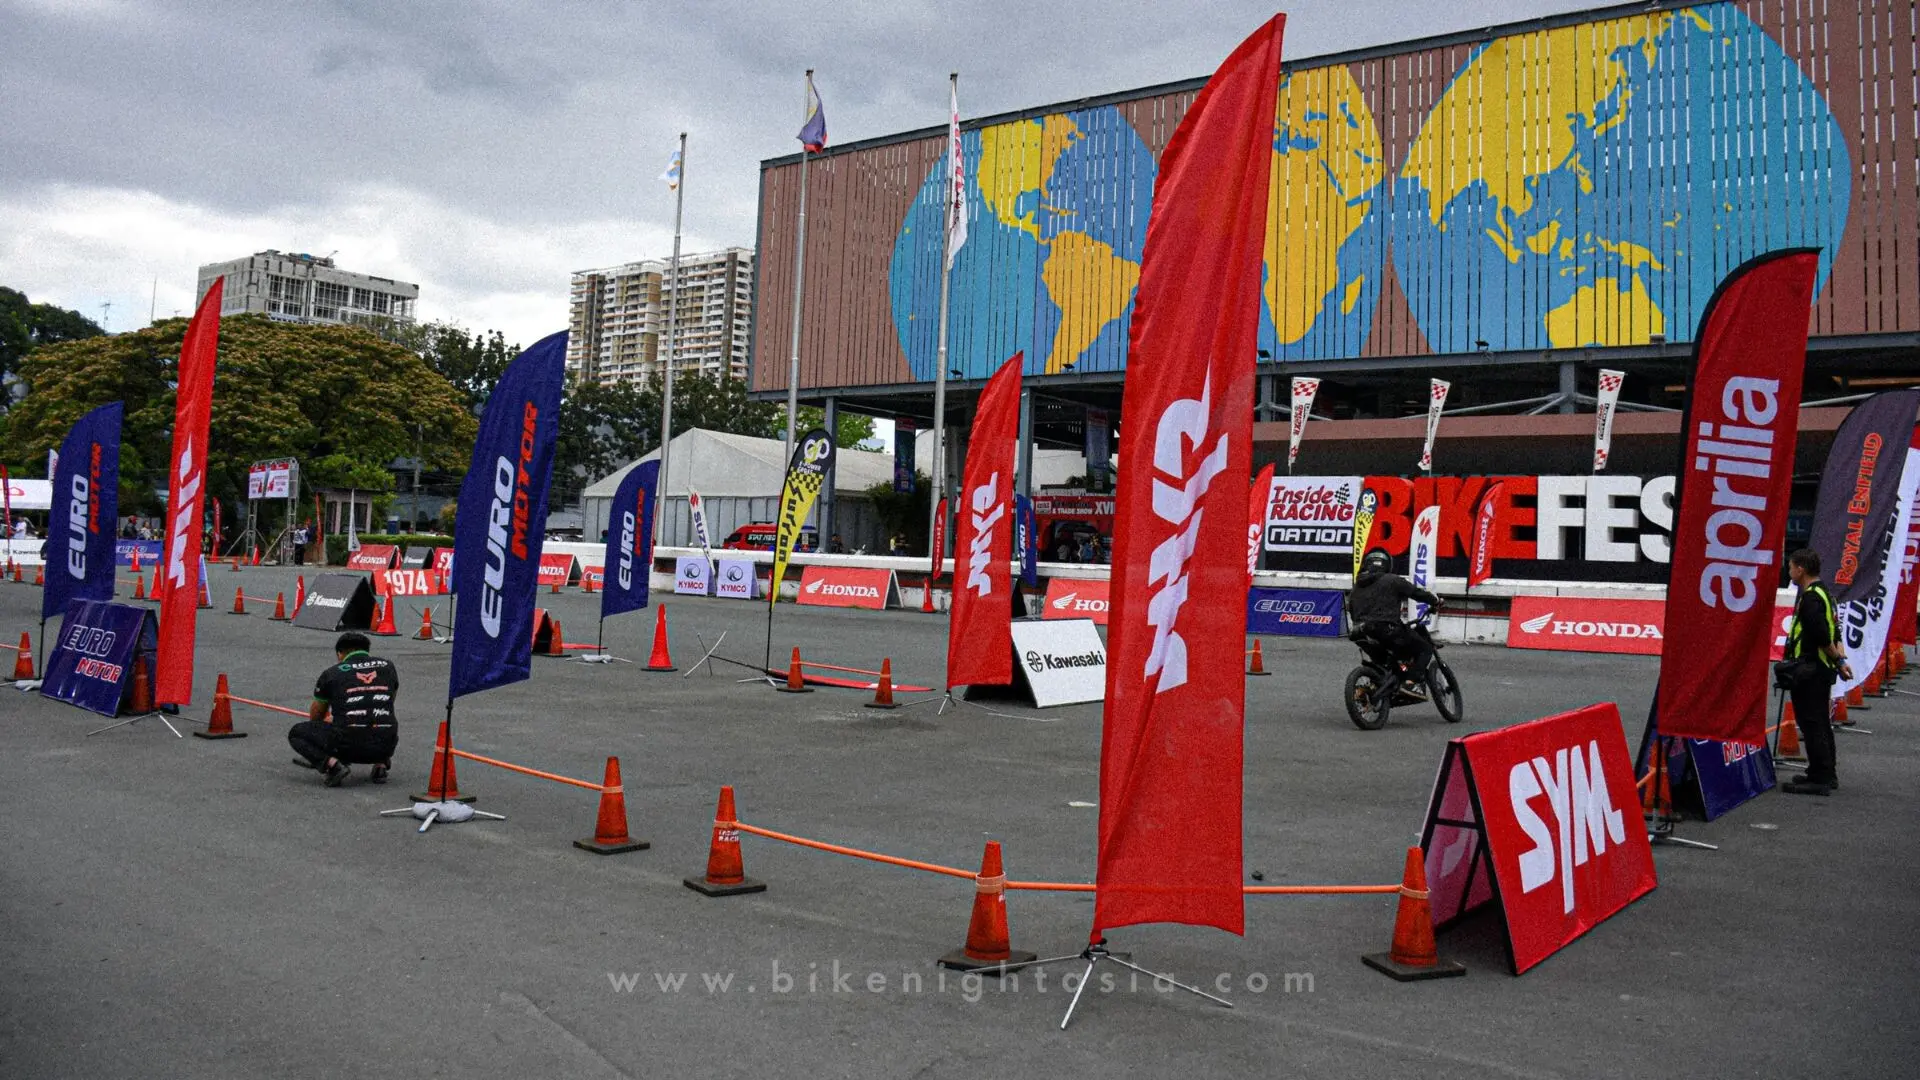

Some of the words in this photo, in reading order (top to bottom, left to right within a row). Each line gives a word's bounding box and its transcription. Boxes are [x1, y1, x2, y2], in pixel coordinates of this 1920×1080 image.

[511, 400, 538, 561] MOTOR
[1848, 432, 1883, 516] ENFIELD
[1271, 485, 1334, 504] Inside
[1695, 375, 1780, 613] aprilia
[1270, 503, 1354, 521] RACING
[68, 473, 89, 580] EURO
[1270, 528, 1353, 543] NATION
[481, 455, 515, 639] EURO
[619, 510, 635, 591] EURO
[1476, 516, 1490, 575] HONDA
[1835, 518, 1864, 585] ROYAL
[360, 556, 387, 565] HONDA
[539, 567, 565, 576] NDA
[384, 570, 428, 595] 1974
[678, 581, 704, 590] KYMCO
[720, 584, 746, 593] KYMCO
[822, 584, 880, 598] HONDA
[1254, 599, 1316, 613] EURO
[1279, 613, 1332, 624] MOTOR
[1551, 620, 1664, 639] HONDA
[63, 624, 117, 657] EURO
[75, 657, 123, 684] MOTOR
[1043, 650, 1105, 670] Kawasaki
[1509, 739, 1626, 914] SYM
